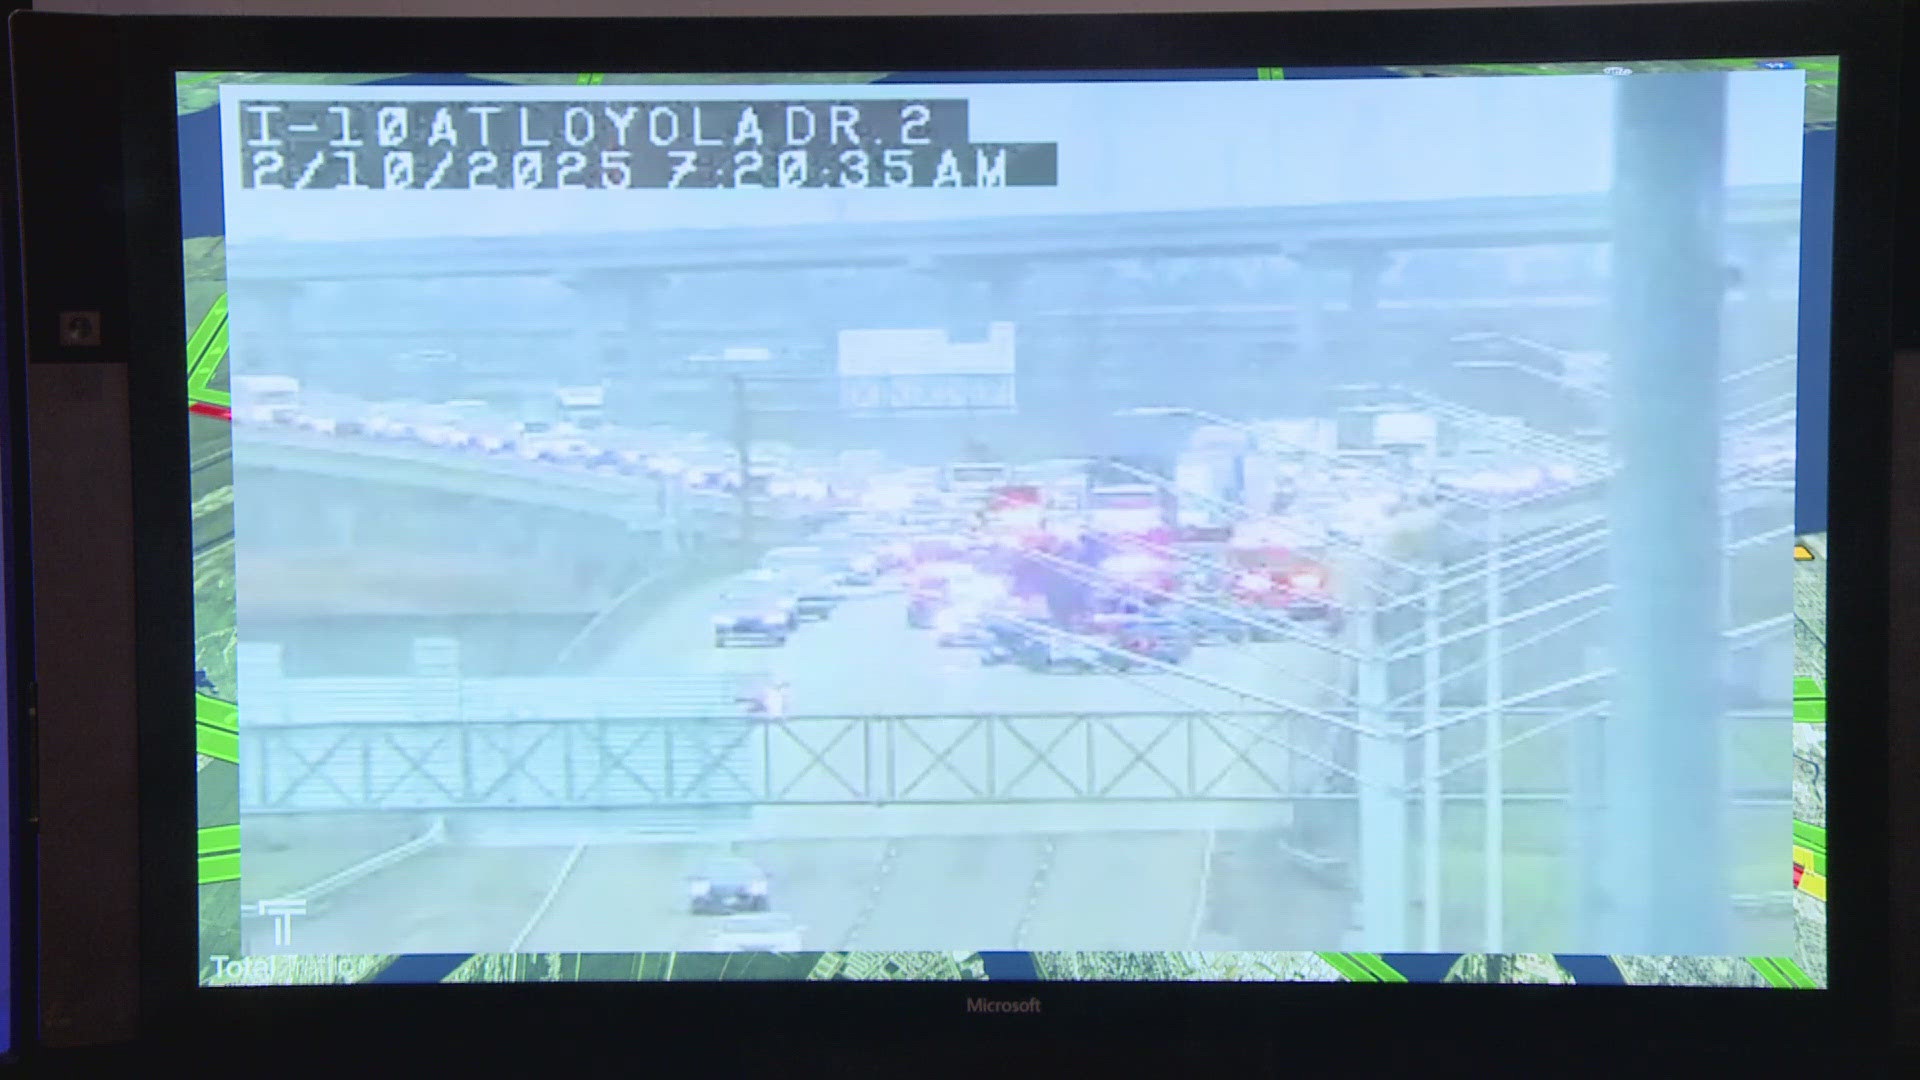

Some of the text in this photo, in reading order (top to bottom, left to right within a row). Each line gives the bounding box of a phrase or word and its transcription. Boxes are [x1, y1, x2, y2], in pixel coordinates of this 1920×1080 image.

[252, 147, 1006, 190] 2/10/2025 7:20:35 AM
[209, 954, 275, 978] Total
[966, 997, 1042, 1013] Microsoft
